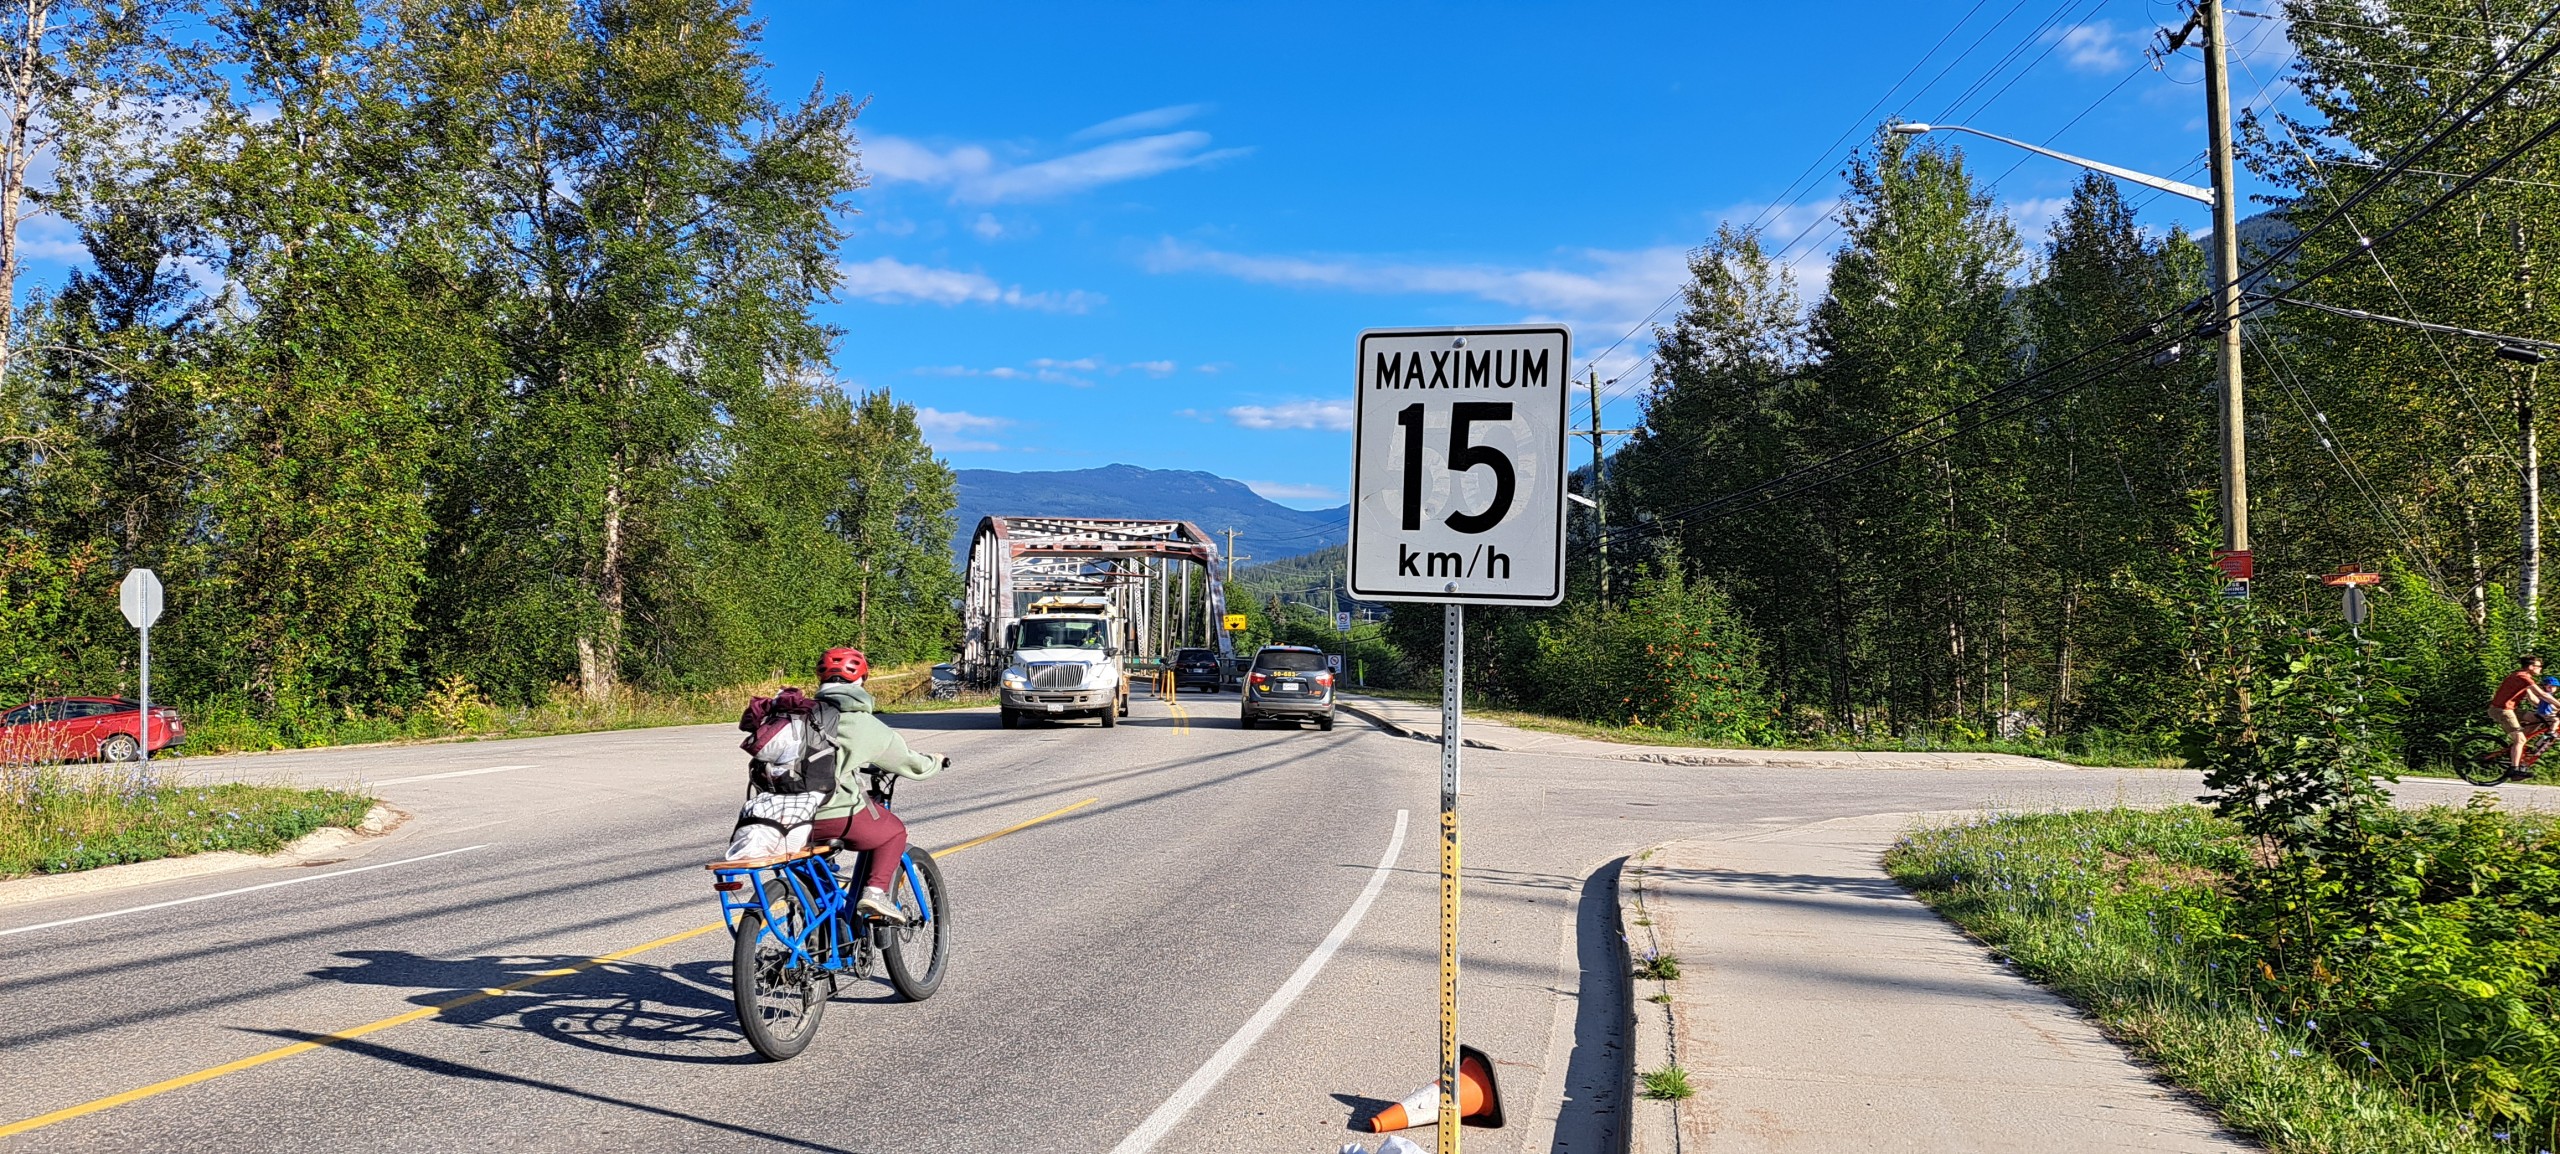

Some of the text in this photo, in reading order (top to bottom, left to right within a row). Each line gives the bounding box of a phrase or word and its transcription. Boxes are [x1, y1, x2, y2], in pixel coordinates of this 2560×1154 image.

[1376, 348, 1549, 389] MAXIMUM
[1398, 402, 1516, 535] 15
[1398, 543, 1511, 579] km/h
